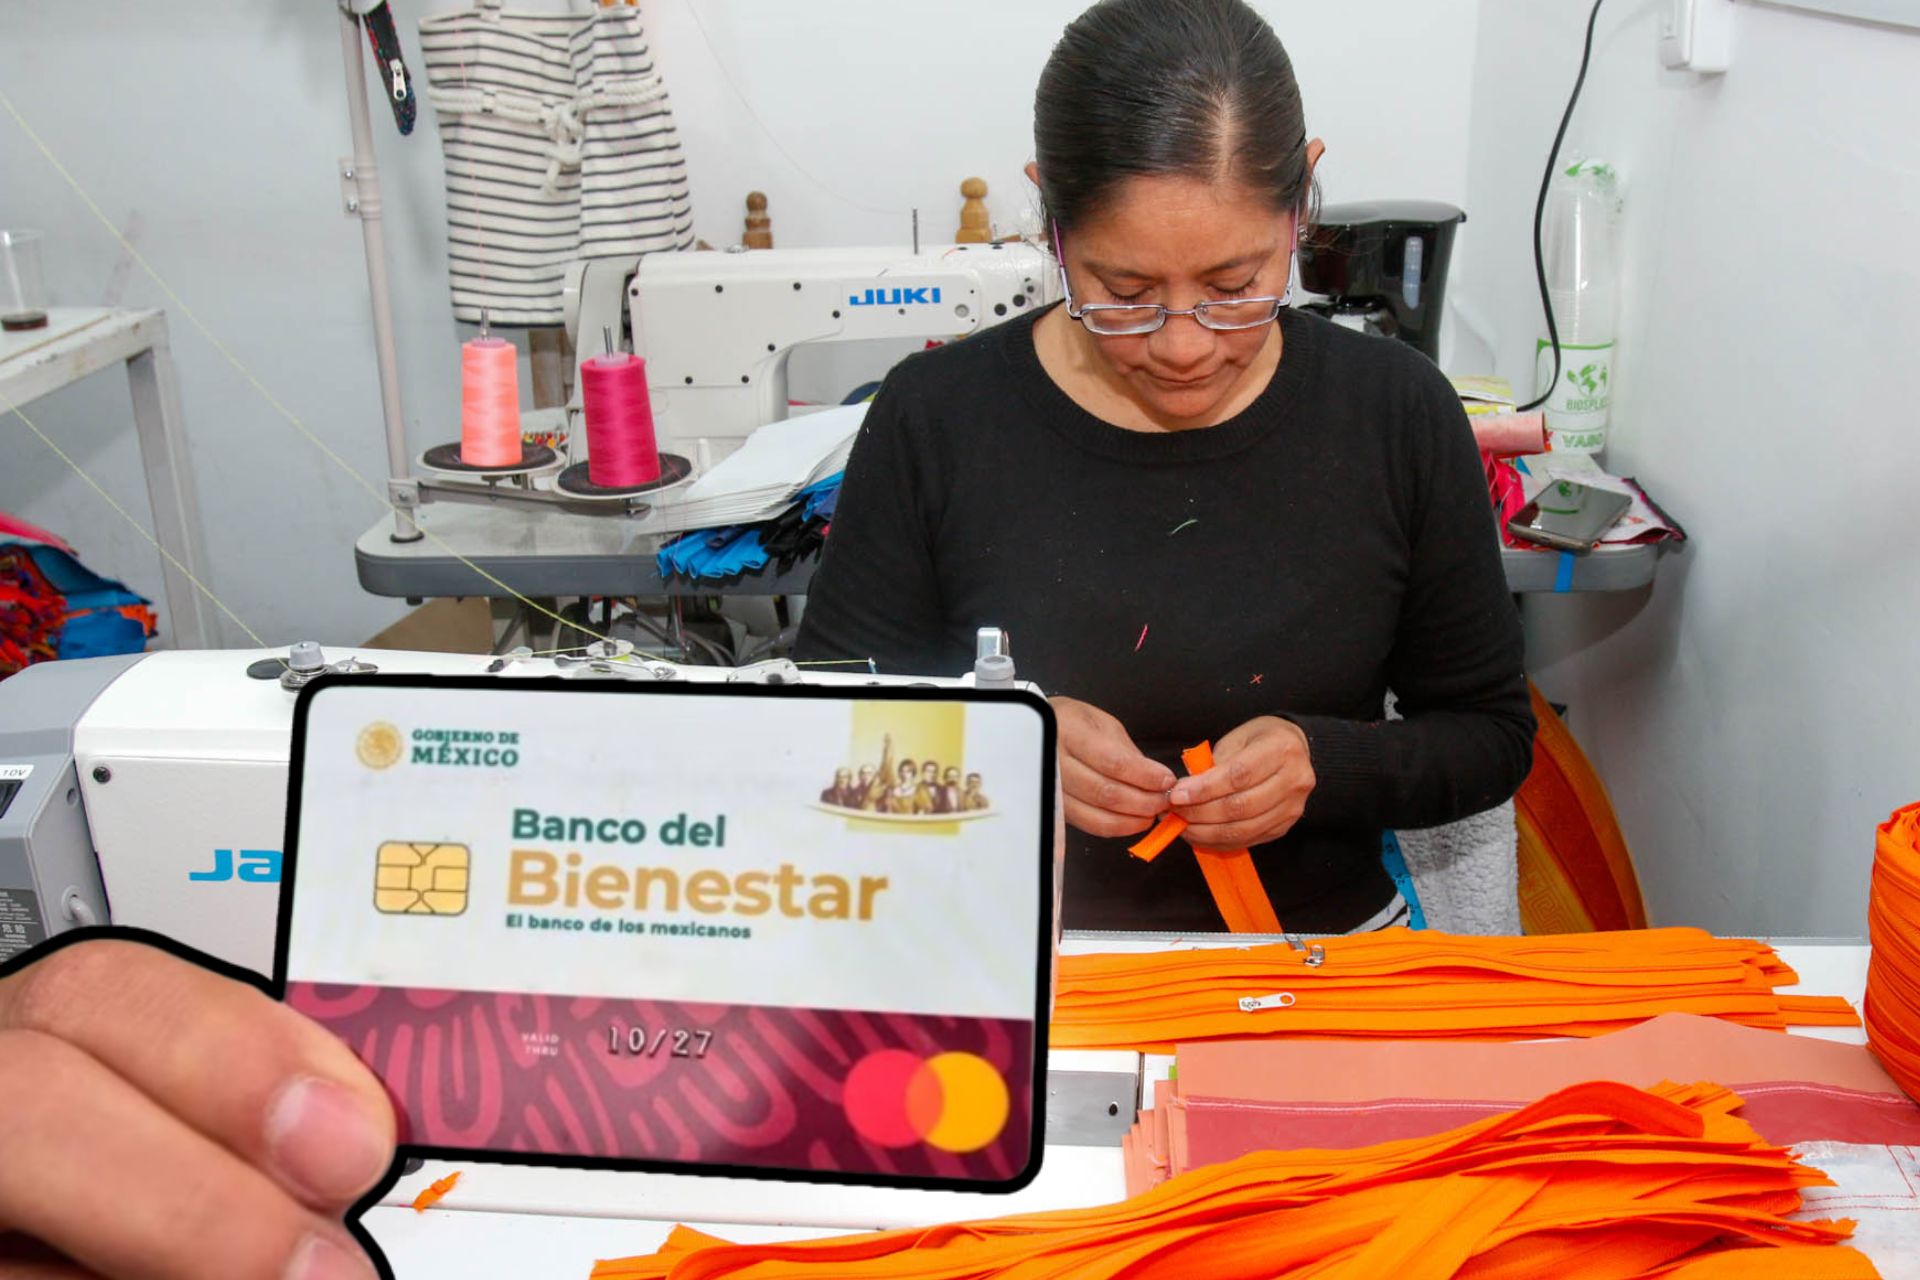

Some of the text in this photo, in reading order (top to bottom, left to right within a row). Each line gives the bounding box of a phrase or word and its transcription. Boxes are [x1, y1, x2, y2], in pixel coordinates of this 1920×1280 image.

[849, 287, 940, 305] JUKI
[412, 729, 519, 744] GOBIERNO DE
[411, 741, 519, 767] MÉXICO
[511, 808, 726, 847] Banco del
[189, 849, 283, 882] Ja
[506, 849, 889, 922] Bienestar
[506, 914, 752, 939] El banco de los mexicanos
[522, 1032, 560, 1044] VALID
[525, 1045, 559, 1056] THRU
[608, 1026, 713, 1058] 10/27
